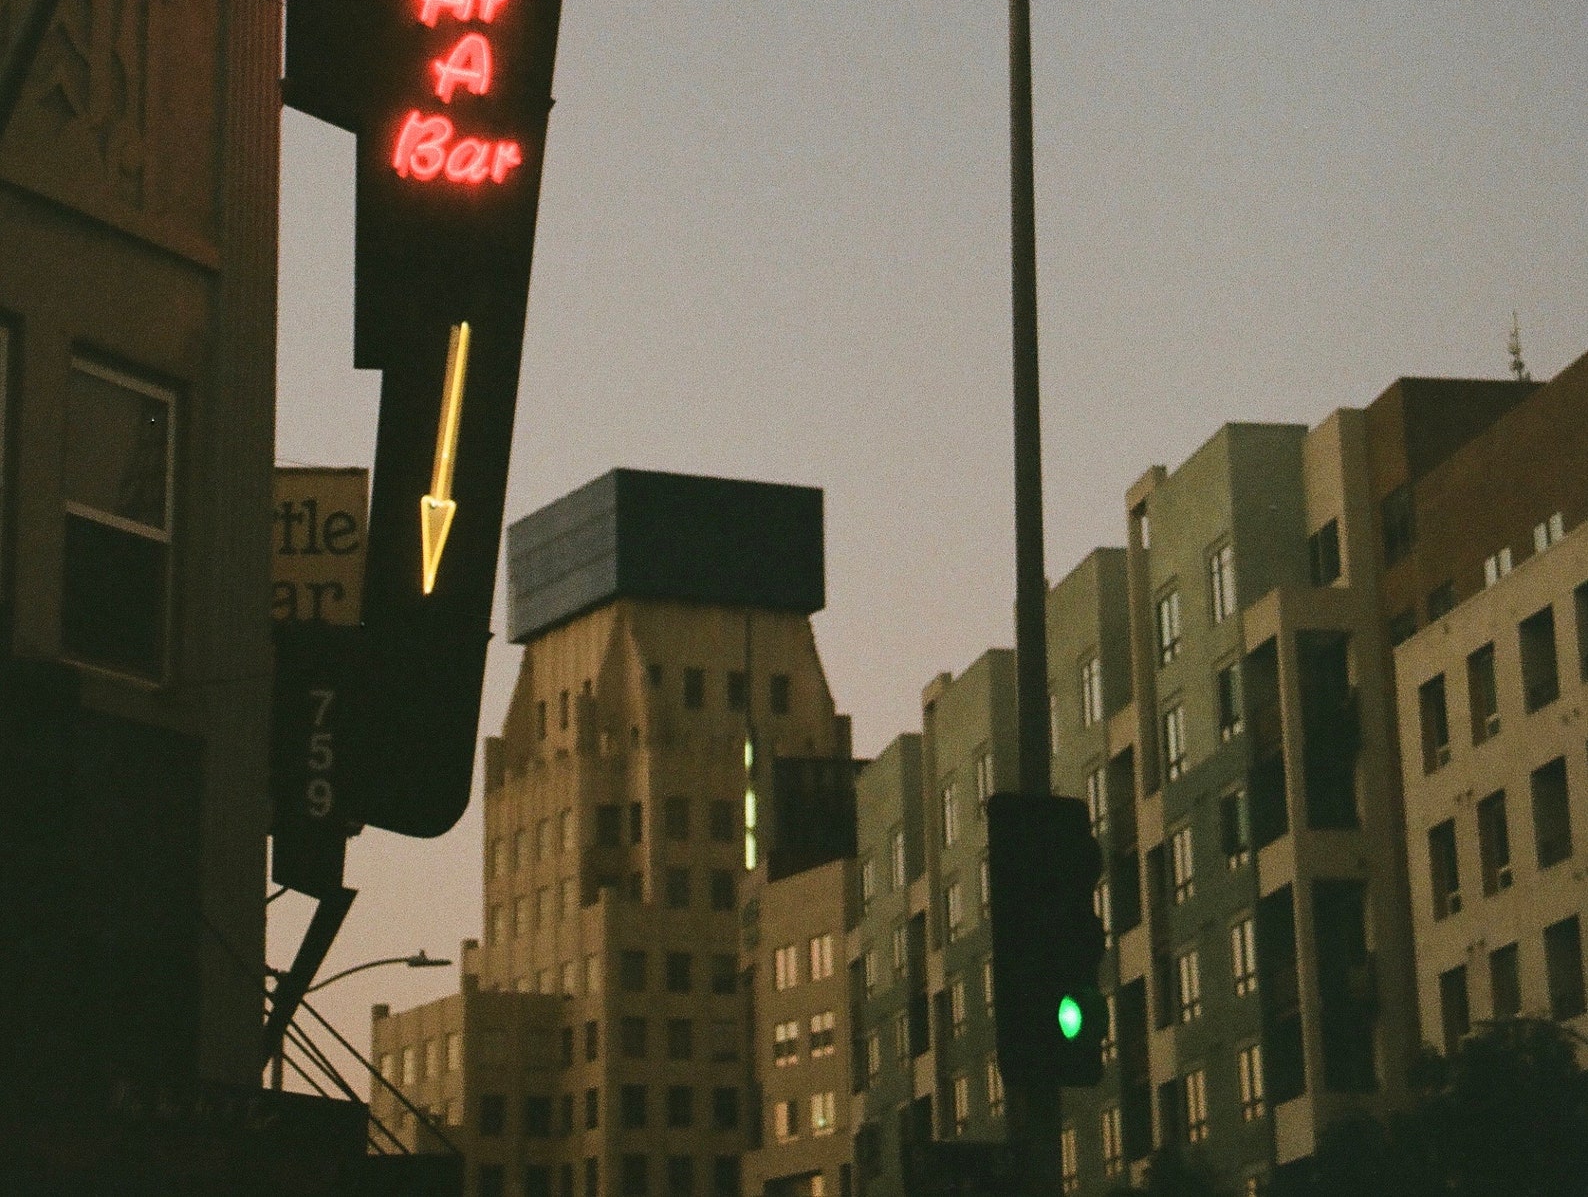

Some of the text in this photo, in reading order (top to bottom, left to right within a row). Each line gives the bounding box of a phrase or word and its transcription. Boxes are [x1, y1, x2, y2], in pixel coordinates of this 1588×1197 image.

[433, 32, 491, 103] A
[392, 109, 522, 183] Bar
[274, 497, 360, 556] tle
